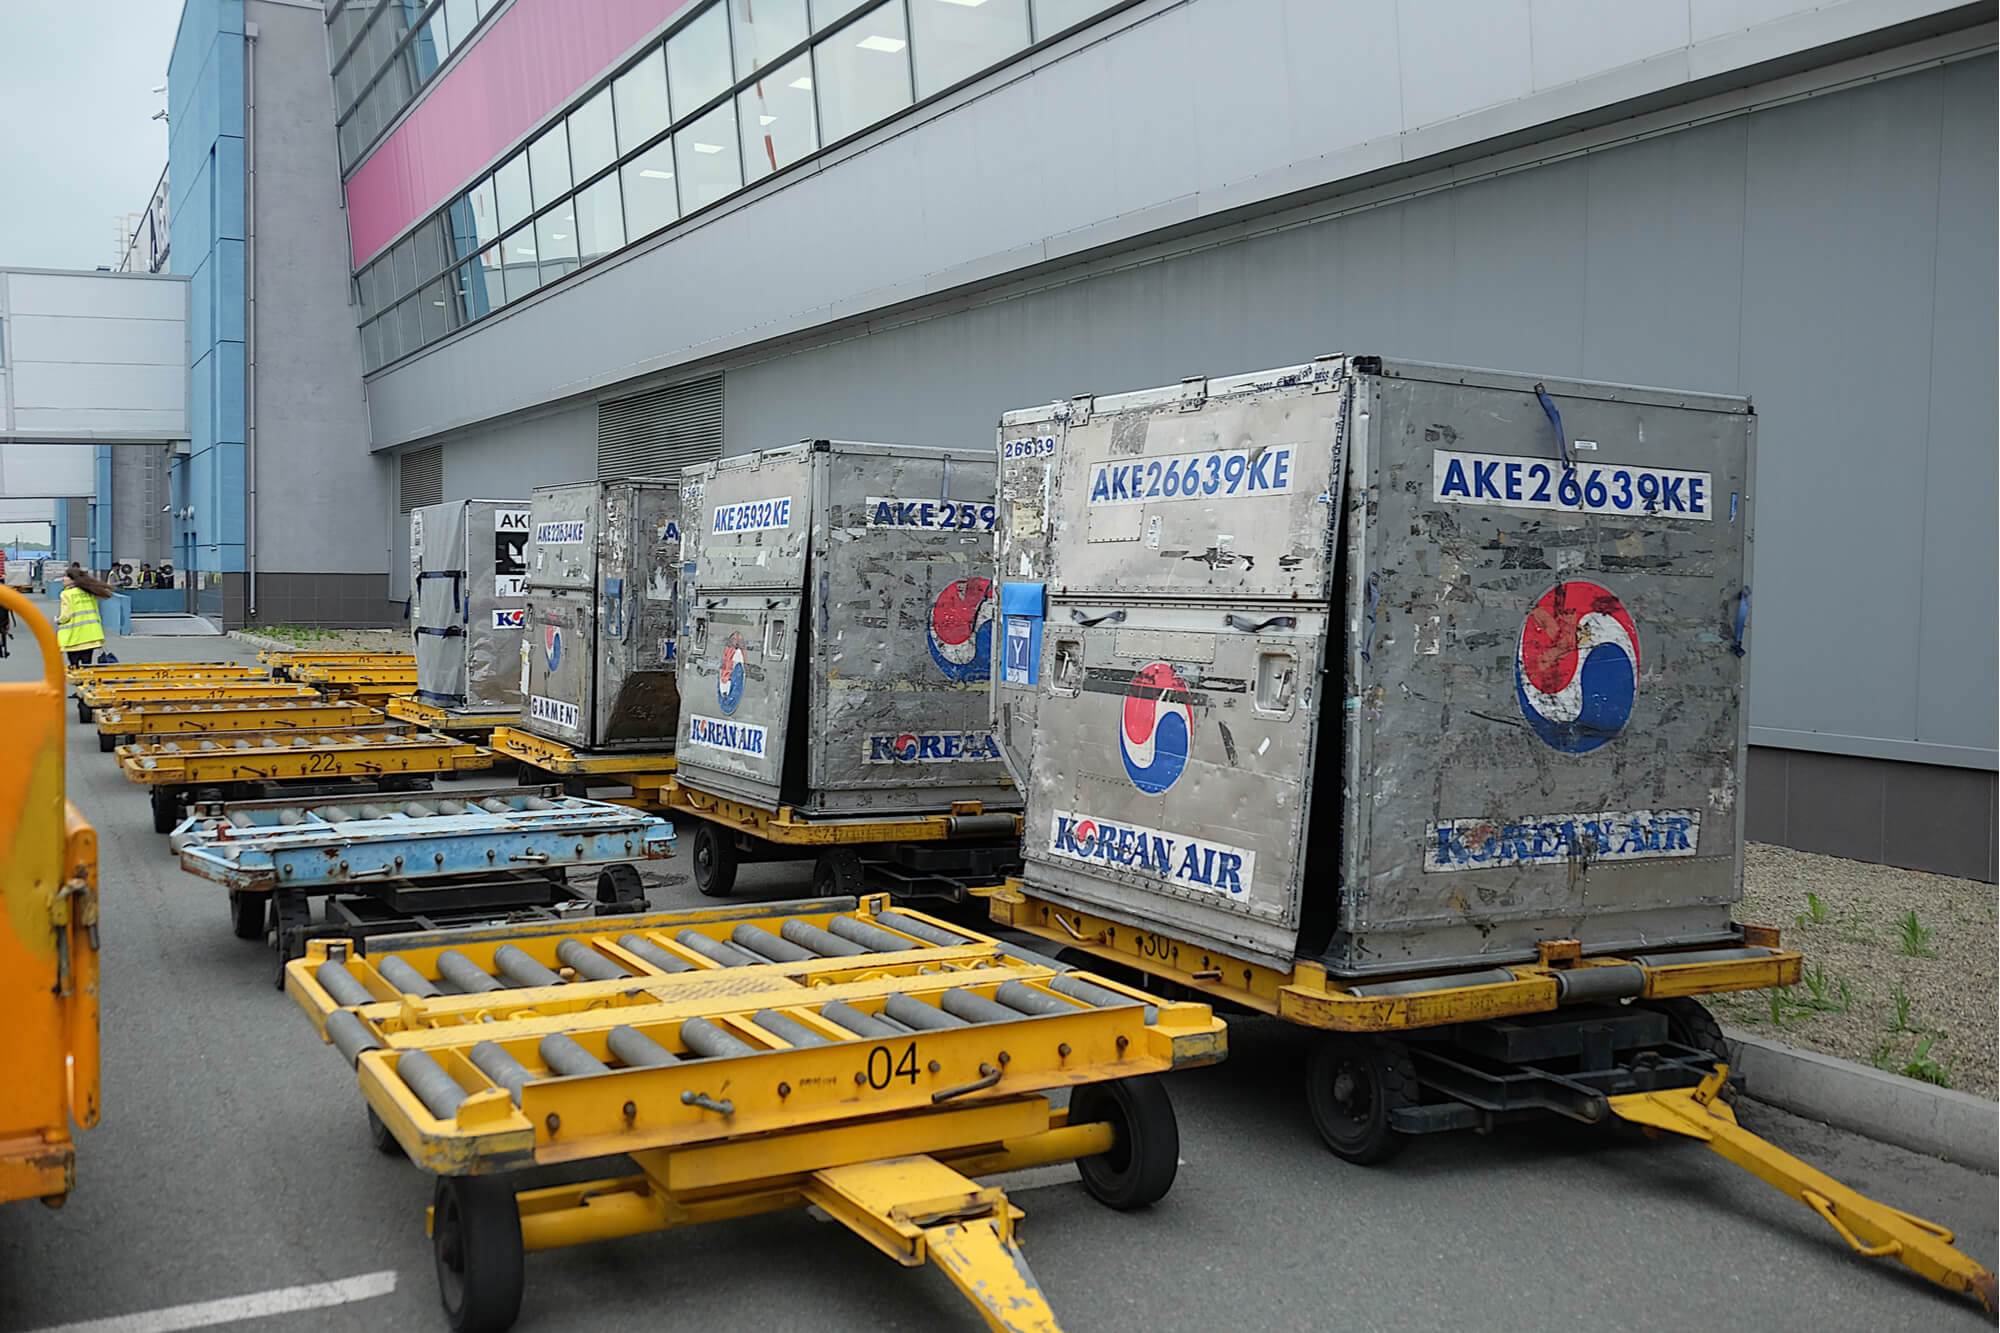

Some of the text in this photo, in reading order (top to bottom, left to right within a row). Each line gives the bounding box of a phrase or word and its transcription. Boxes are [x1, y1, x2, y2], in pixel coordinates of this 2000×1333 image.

[1005, 438, 1054, 458] 26639
[1091, 450, 1290, 501] AKE26639KE
[1440, 459, 1704, 513] AKE26639KE
[501, 513, 530, 528] AK
[713, 500, 790, 532] AKE 25932 KE
[1013, 639, 1024, 665] Y
[532, 697, 578, 727] GARMENT
[692, 719, 763, 753] KOREAN AIR
[309, 753, 335, 772] 22
[1055, 817, 1242, 893] KOREAN AIR
[1435, 818, 1690, 865] KOREAN AIR
[867, 1041, 921, 1090] 04
